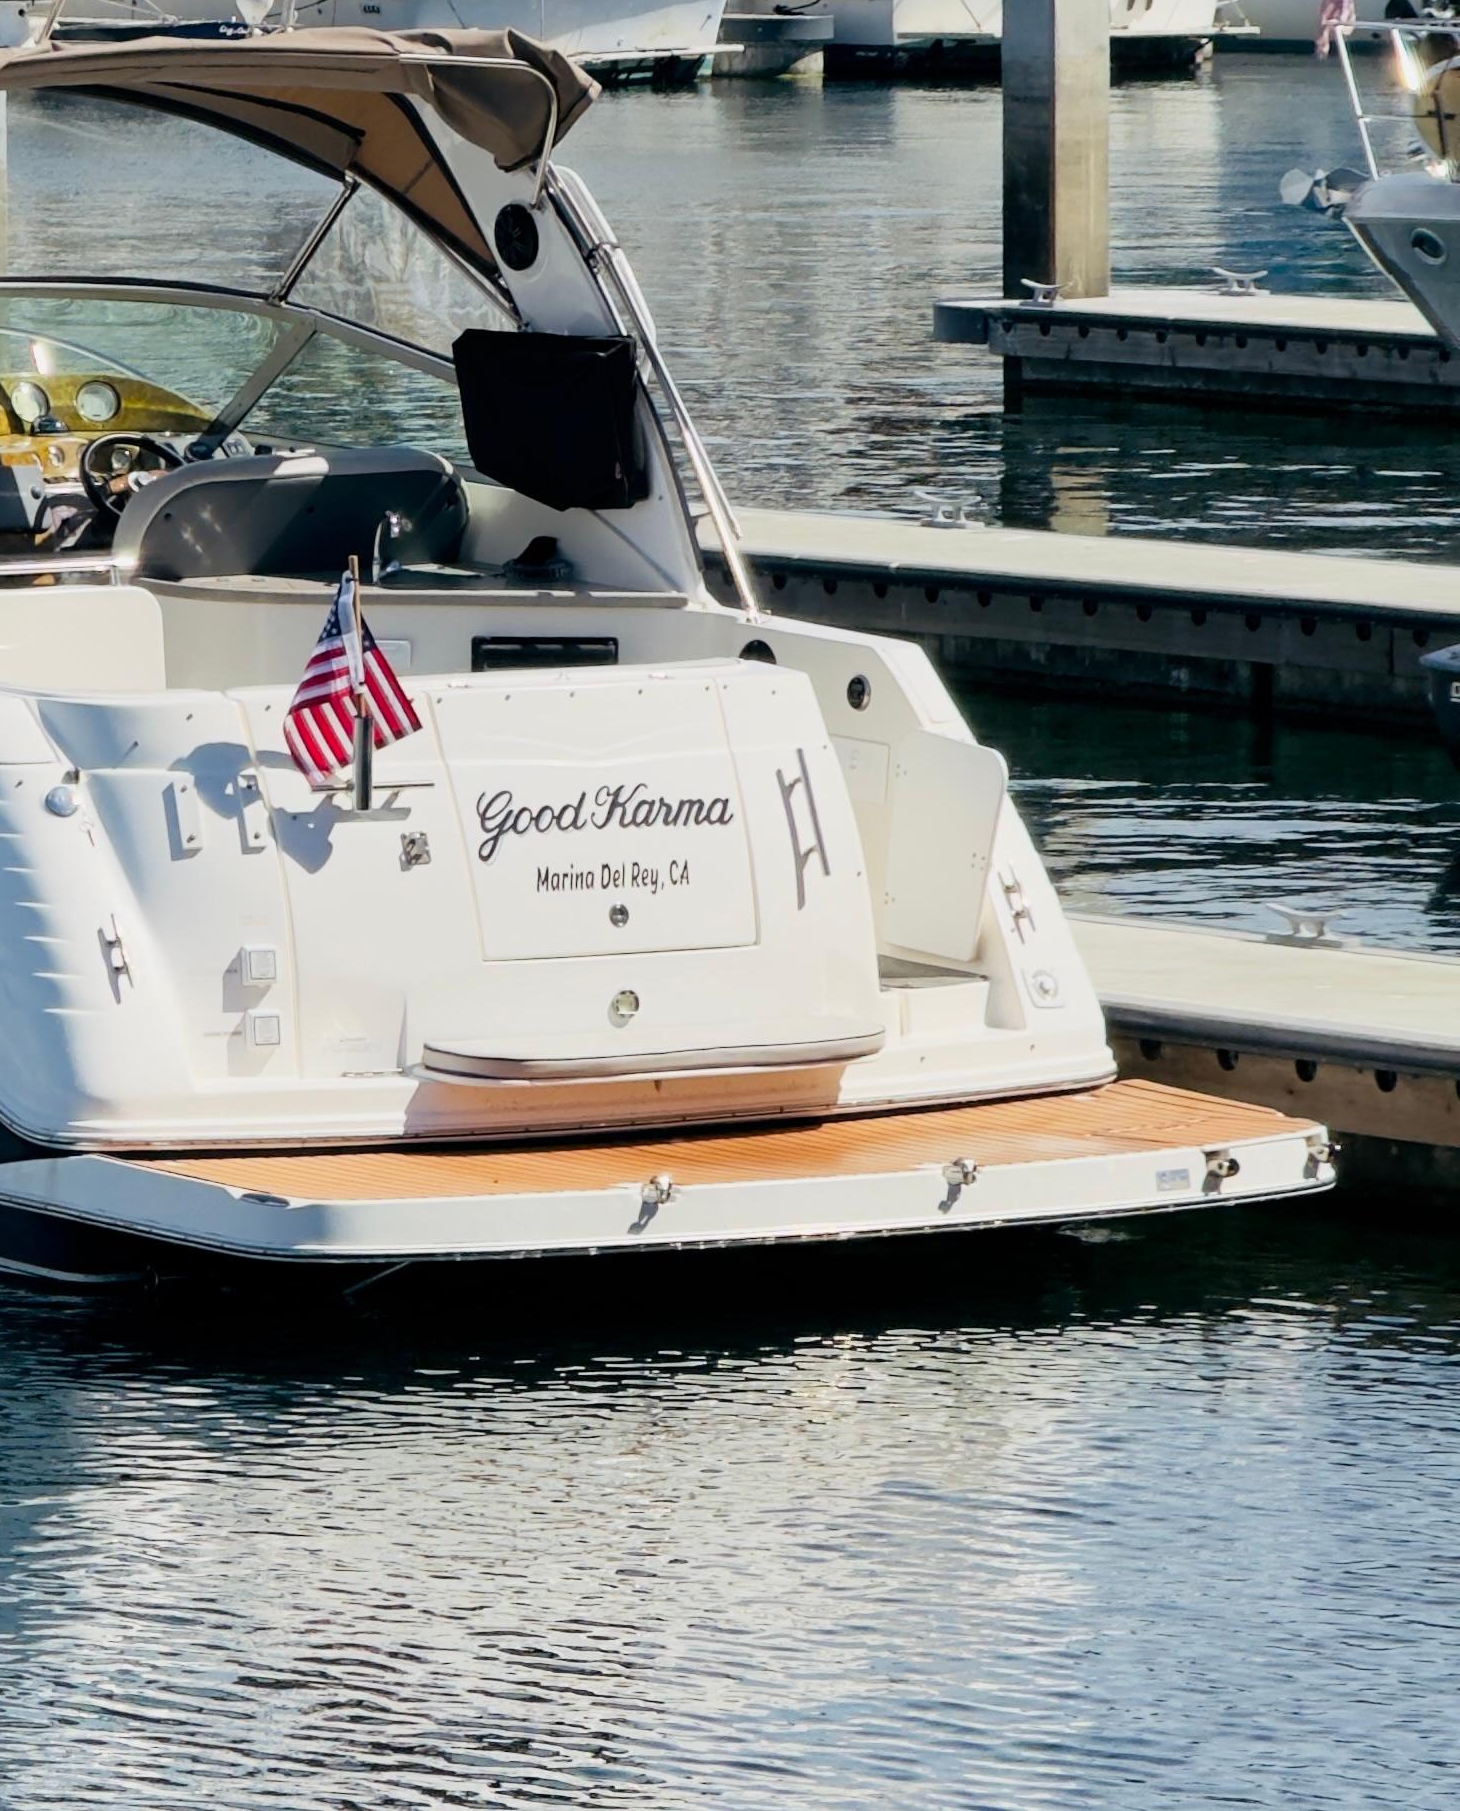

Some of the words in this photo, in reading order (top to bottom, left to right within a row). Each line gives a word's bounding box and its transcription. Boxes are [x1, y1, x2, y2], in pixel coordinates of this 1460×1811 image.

[476, 790, 588, 863] Good
[590, 783, 734, 830] Karma
[536, 863, 595, 892] Marina
[600, 861, 626, 890] Del
[631, 860, 666, 894] Rey,
[669, 859, 690, 887] CA
